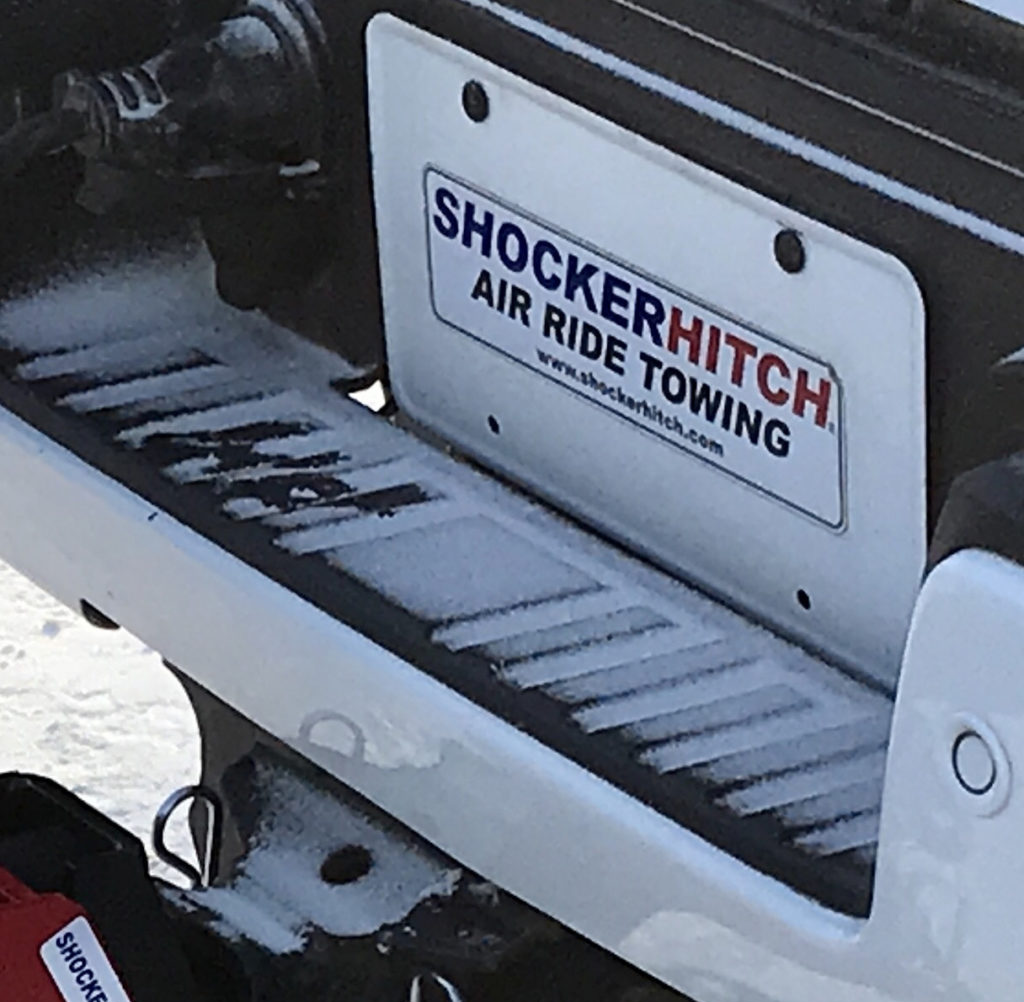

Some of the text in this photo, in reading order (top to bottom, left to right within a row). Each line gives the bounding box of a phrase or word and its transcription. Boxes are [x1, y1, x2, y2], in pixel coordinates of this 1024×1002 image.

[471, 269, 792, 458] AIR RIDE TOWING
[536, 347, 725, 457] www.shockerhitch.com
